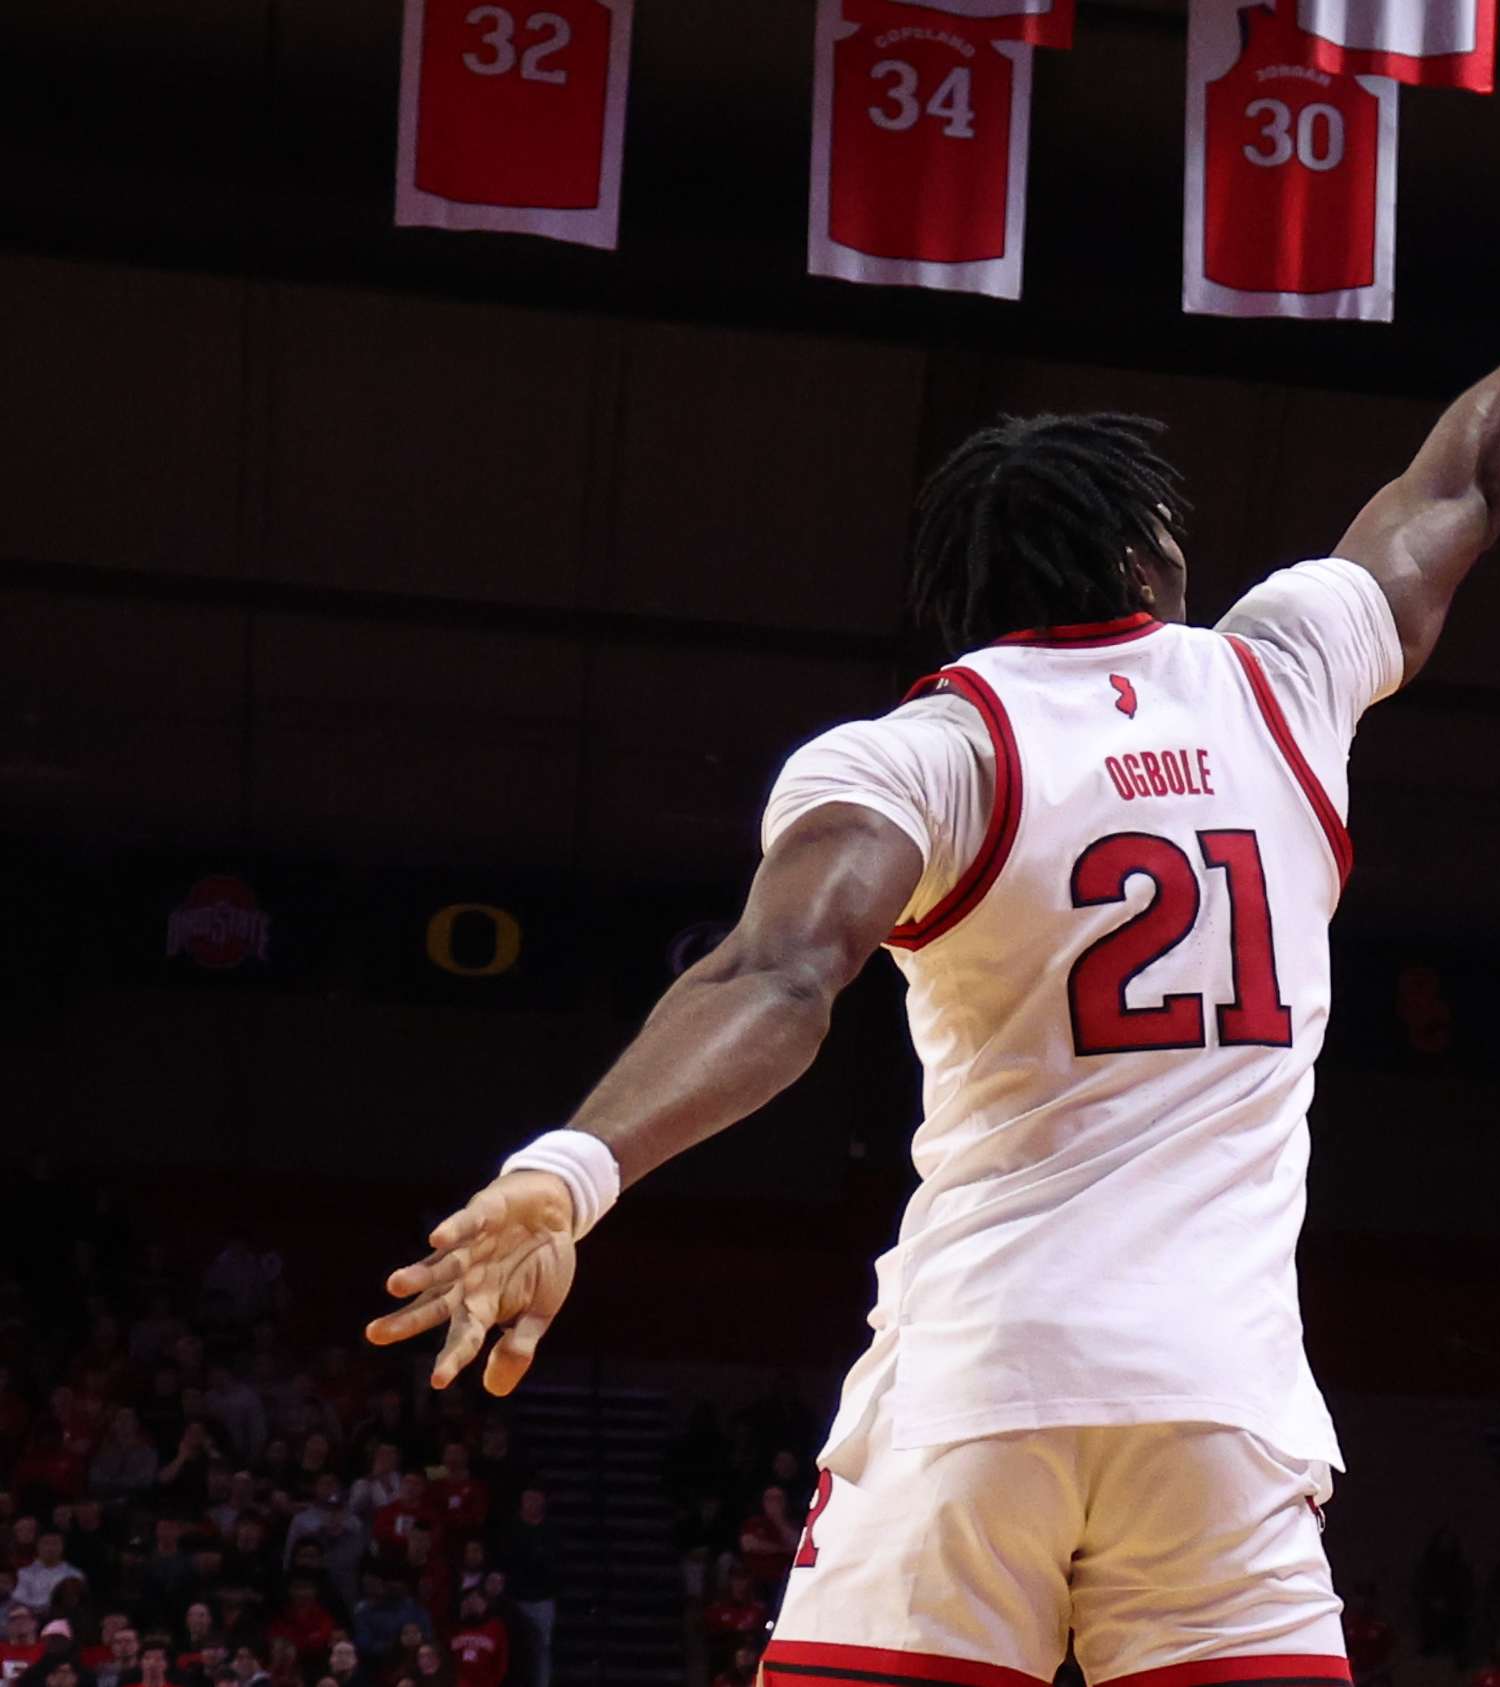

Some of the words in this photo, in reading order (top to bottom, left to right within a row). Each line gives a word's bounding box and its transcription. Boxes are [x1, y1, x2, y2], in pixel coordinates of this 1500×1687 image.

[461, 5, 572, 85] 32
[867, 59, 977, 139] 34
[1243, 98, 1344, 172] 30
[1105, 749, 1214, 801] OGBOLE
[424, 902, 523, 977] O
[1067, 828, 1293, 1056] 21
